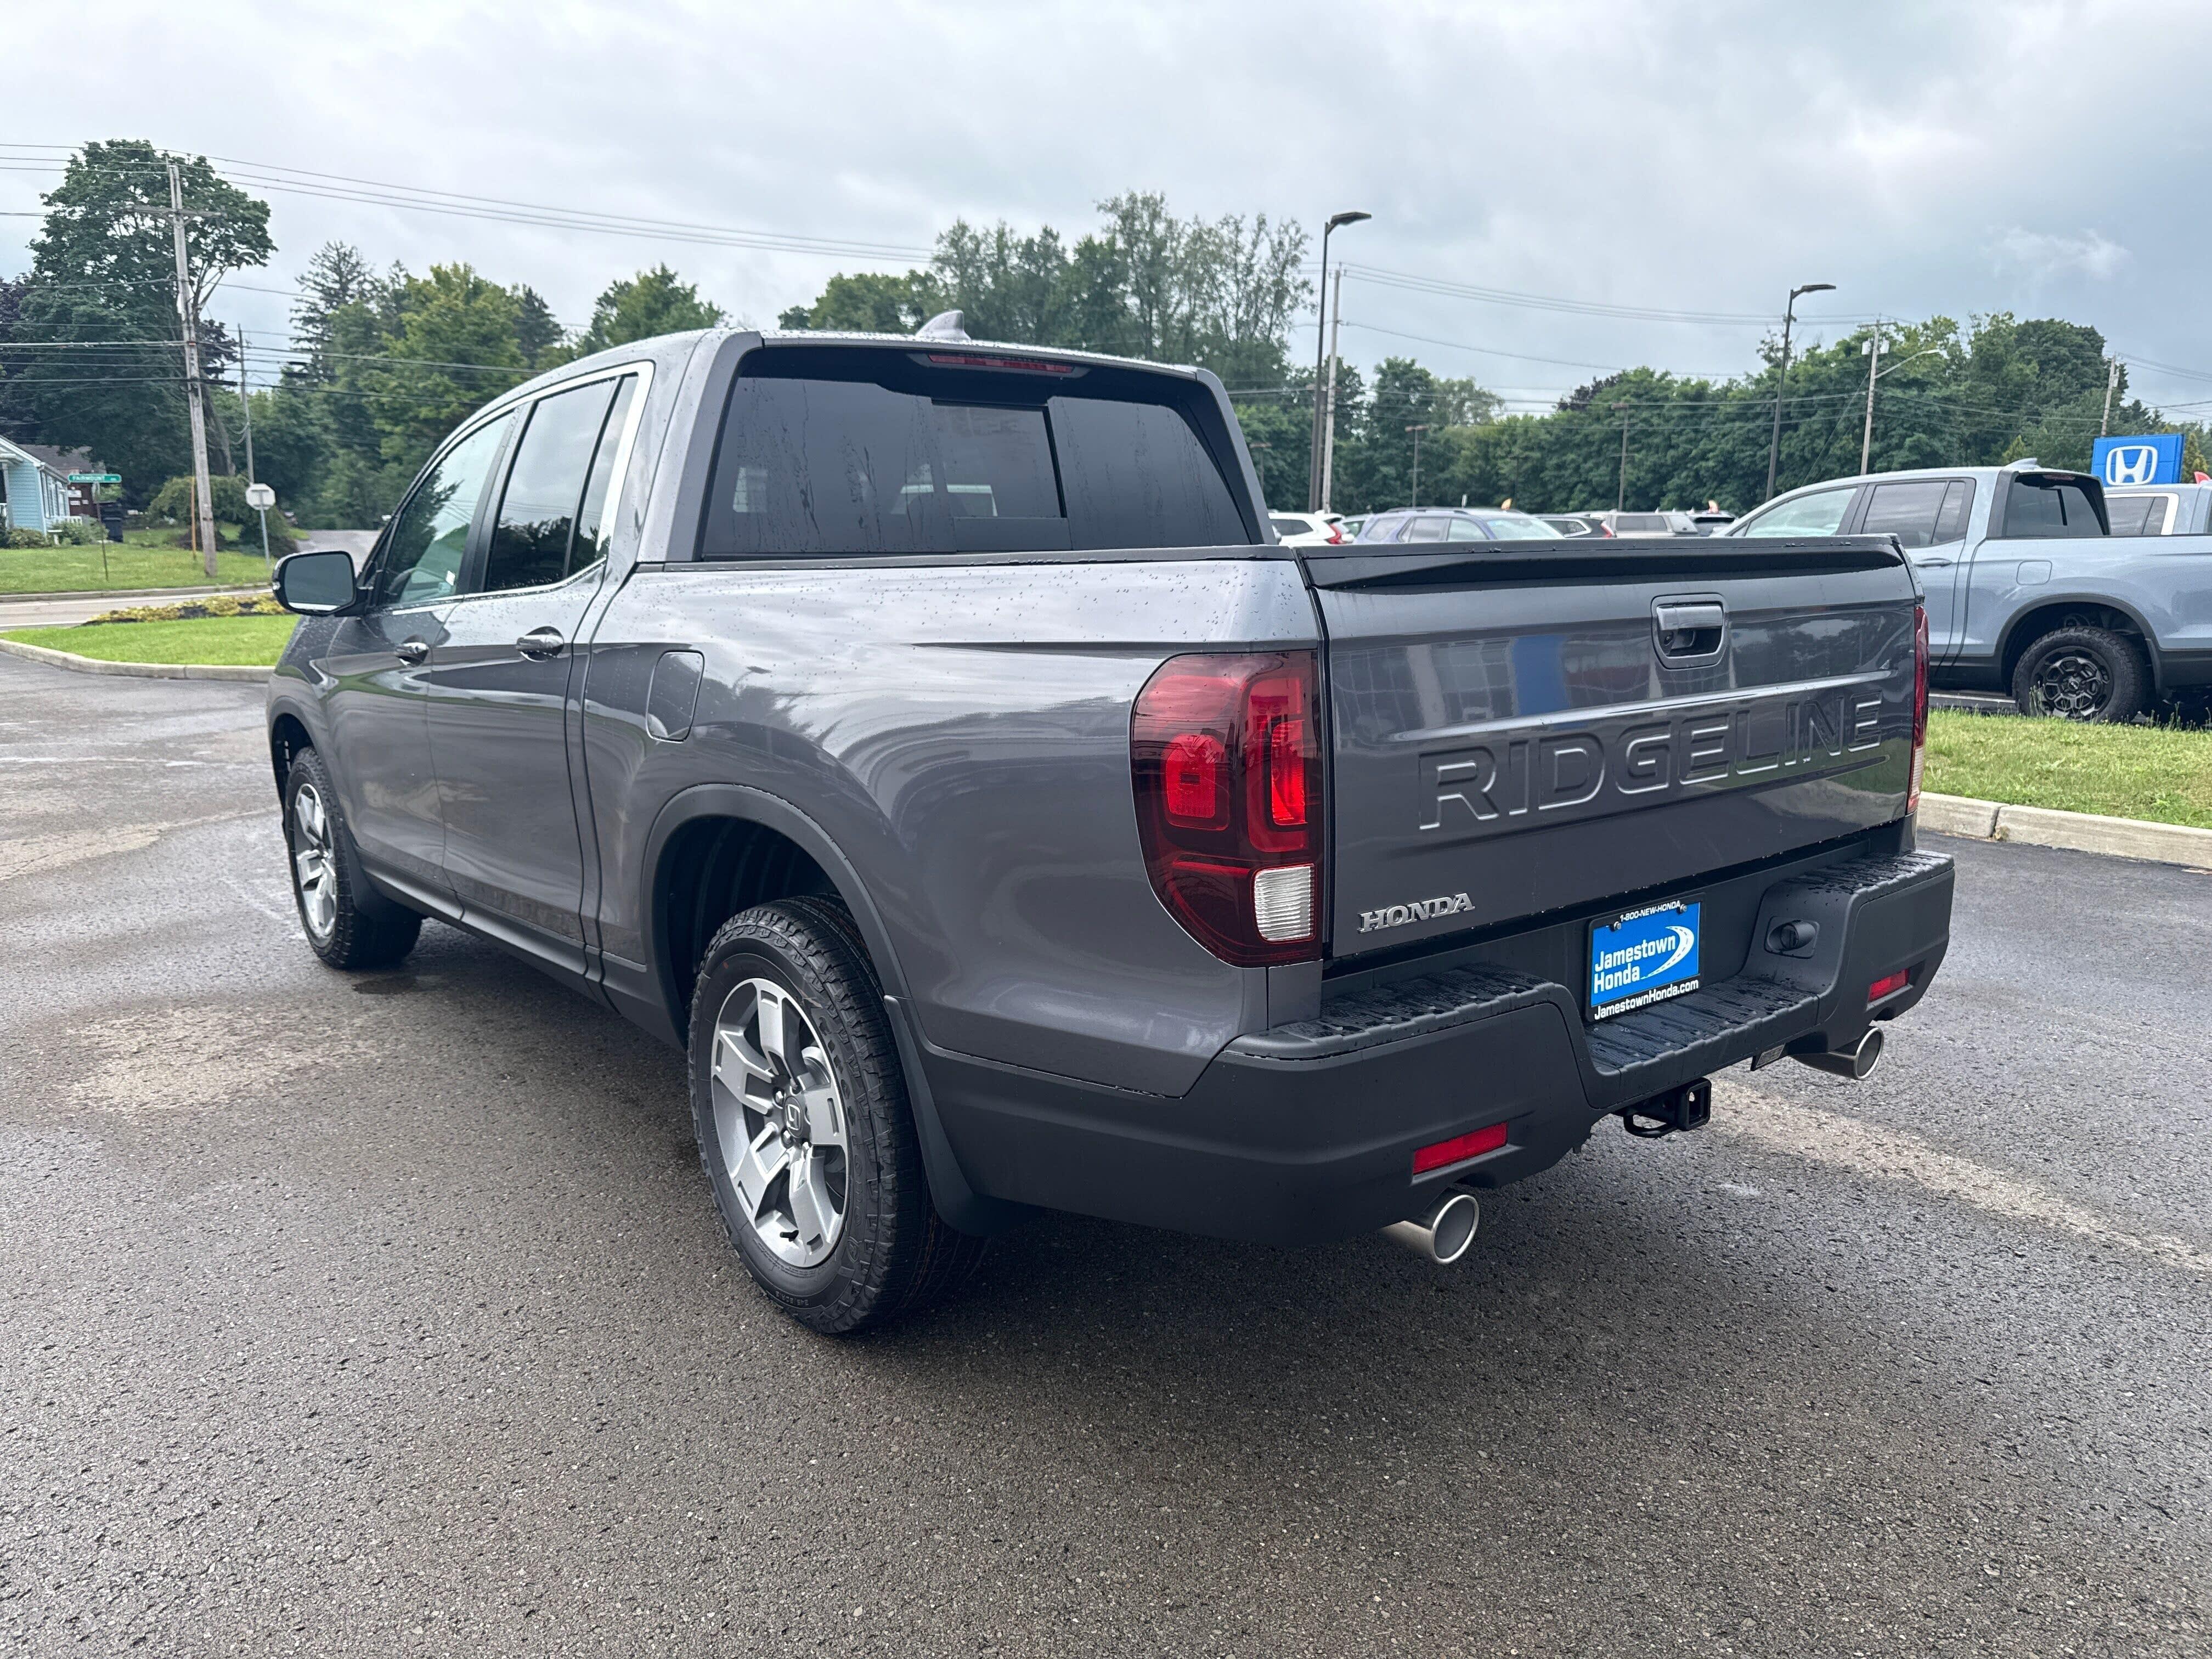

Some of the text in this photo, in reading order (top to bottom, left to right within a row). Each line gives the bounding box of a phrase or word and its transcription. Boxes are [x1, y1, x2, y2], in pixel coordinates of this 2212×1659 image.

[1419, 691, 1883, 830] RIDGELINE
[1357, 893, 1476, 933] HONDA
[1620, 900, 1681, 922] 1-800-NEW-HONDA
[1594, 935, 1676, 972] Jamestown
[1593, 963, 1641, 994] Honda
[1594, 979, 1699, 1020] JamestownHonda.com
